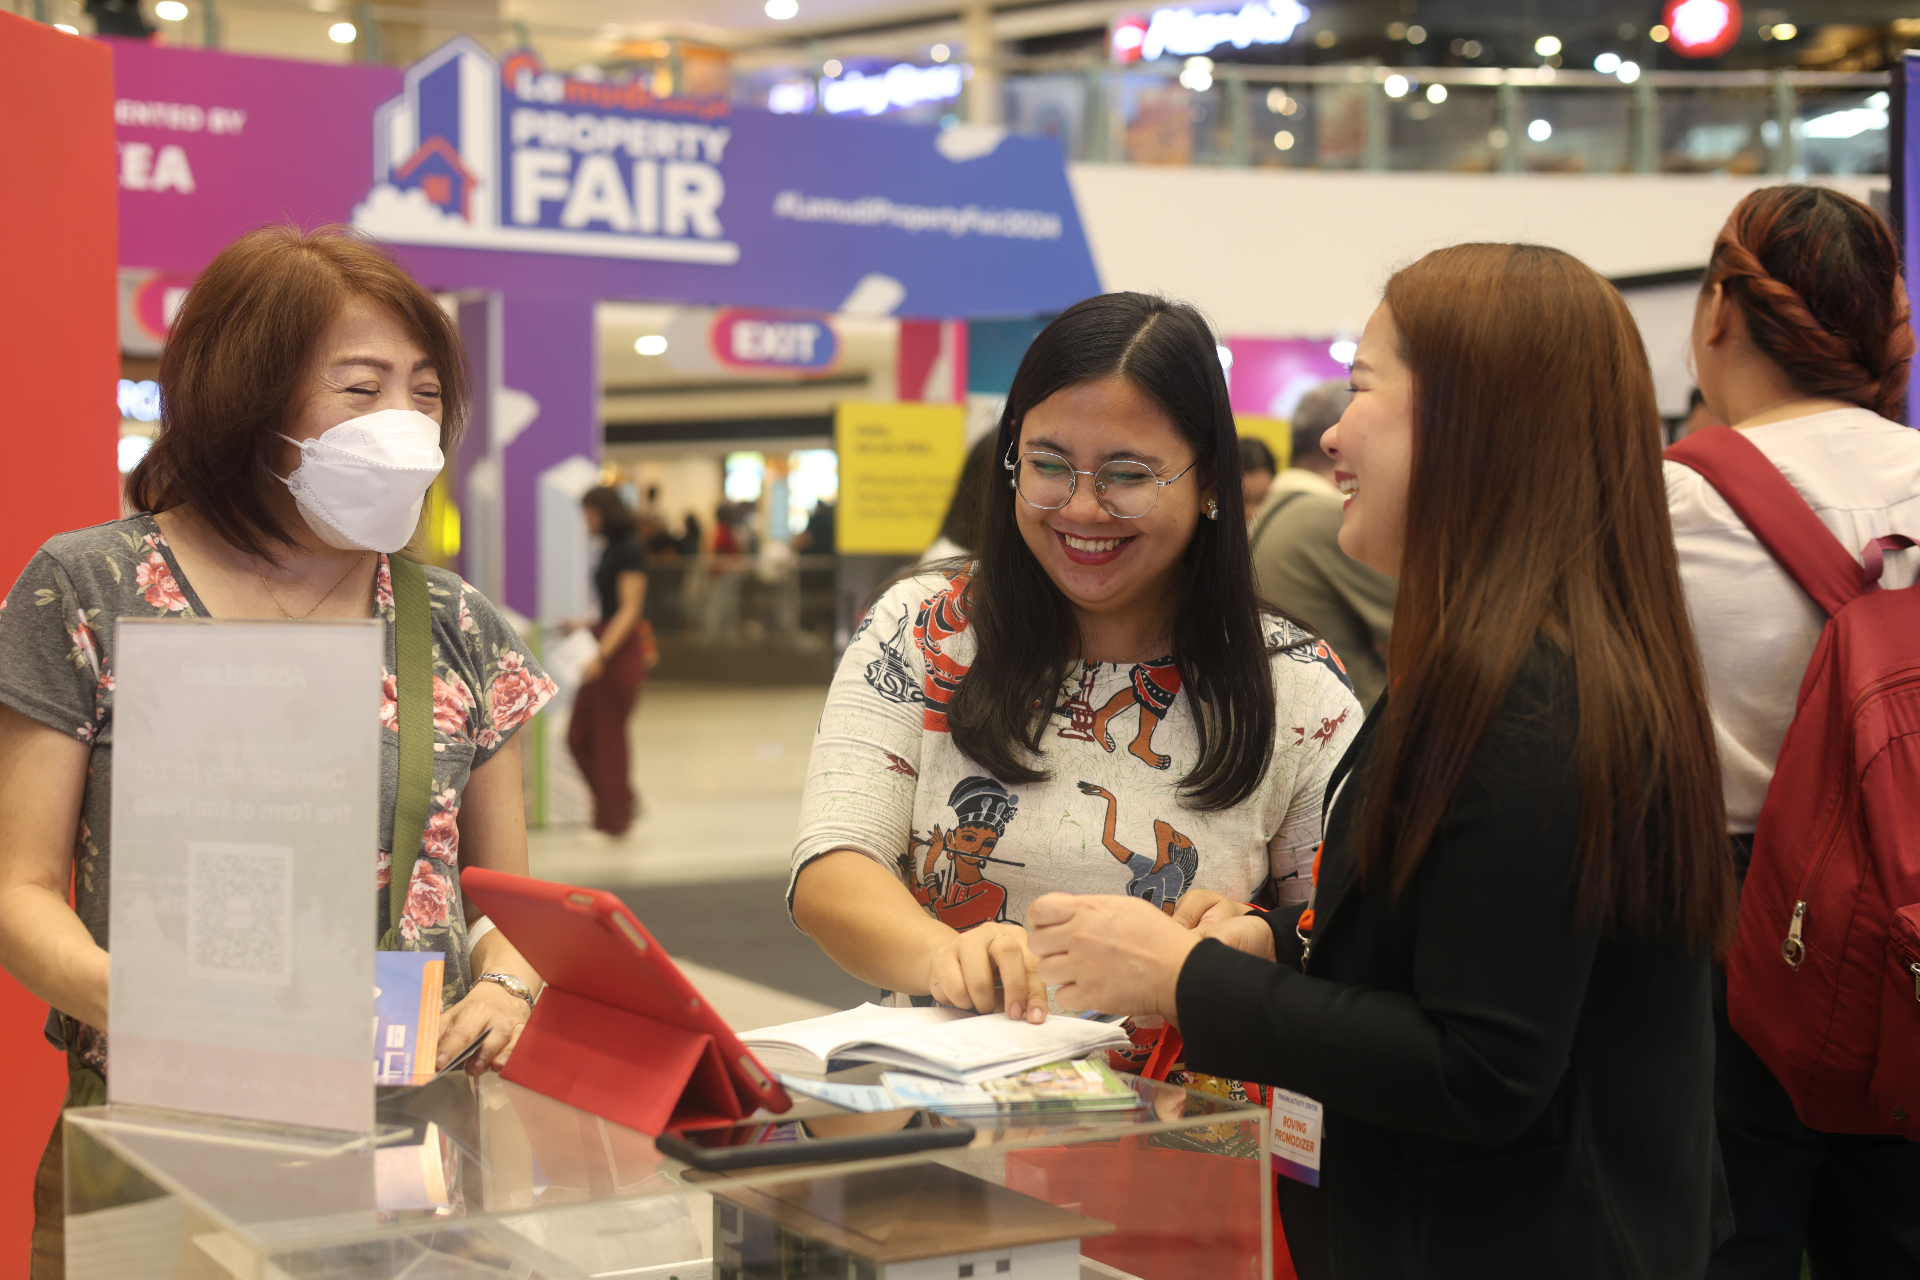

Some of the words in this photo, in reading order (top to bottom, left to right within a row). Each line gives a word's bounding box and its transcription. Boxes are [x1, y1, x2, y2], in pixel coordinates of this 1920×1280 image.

[207, 107, 248, 136] BY
[510, 107, 732, 164] PROPERTY
[117, 141, 196, 195] EA
[512, 150, 724, 237] FAIR
[730, 320, 821, 364] EXIT
[1305, 1101, 1318, 1111] CENTER
[1274, 1128, 1315, 1153] PROMODIZER
[1282, 1115, 1307, 1134] ROVING
